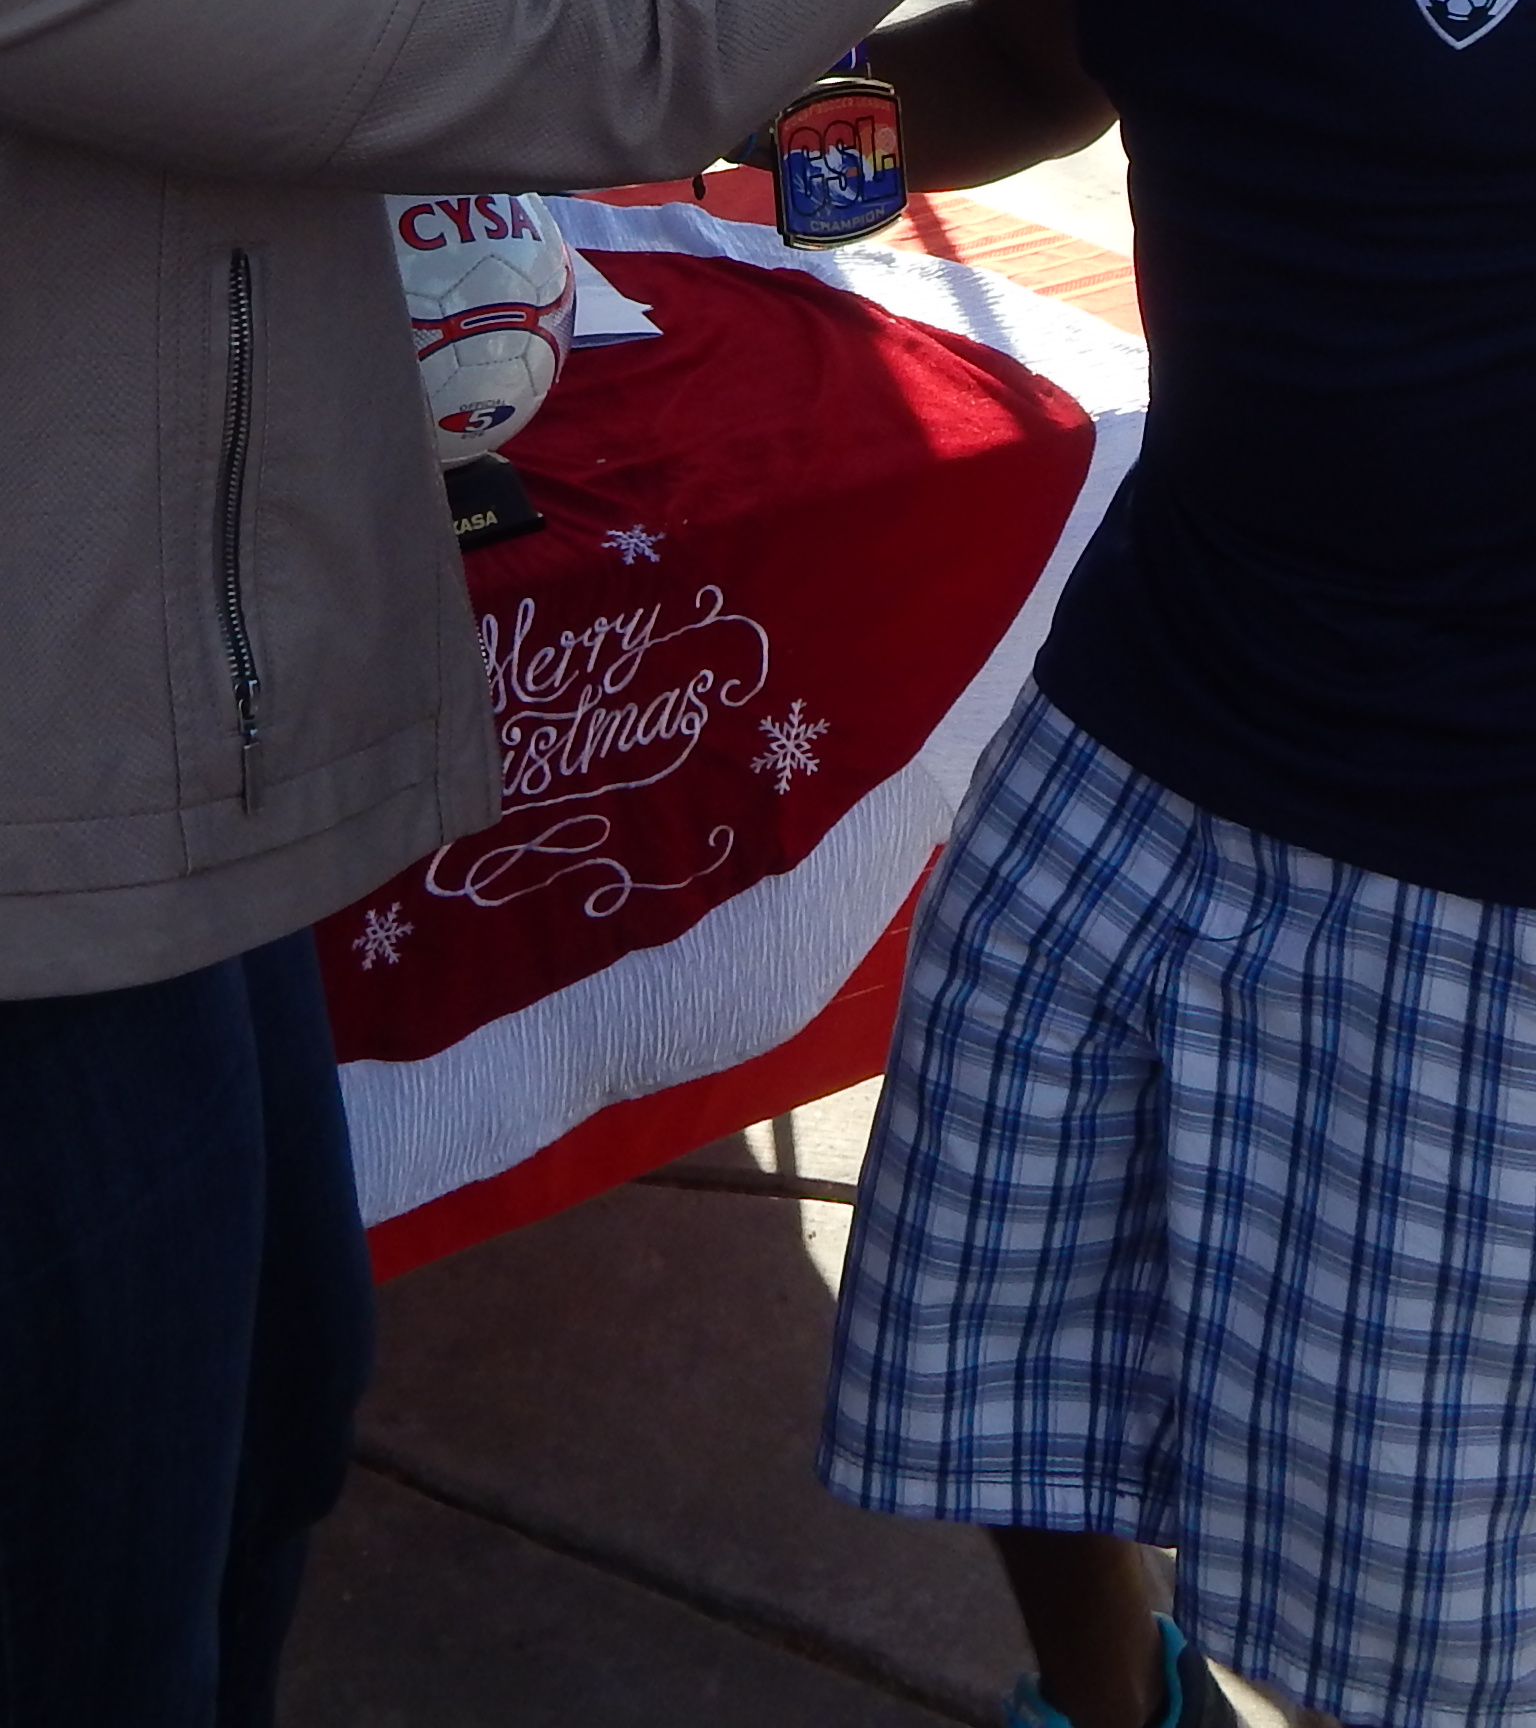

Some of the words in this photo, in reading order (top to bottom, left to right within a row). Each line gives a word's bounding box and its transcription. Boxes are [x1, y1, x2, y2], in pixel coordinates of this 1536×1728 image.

[398, 194, 542, 250] CYSA
[810, 206, 886, 233] CHAMPION
[464, 407, 497, 432] 5
[502, 669, 714, 795] istmas
